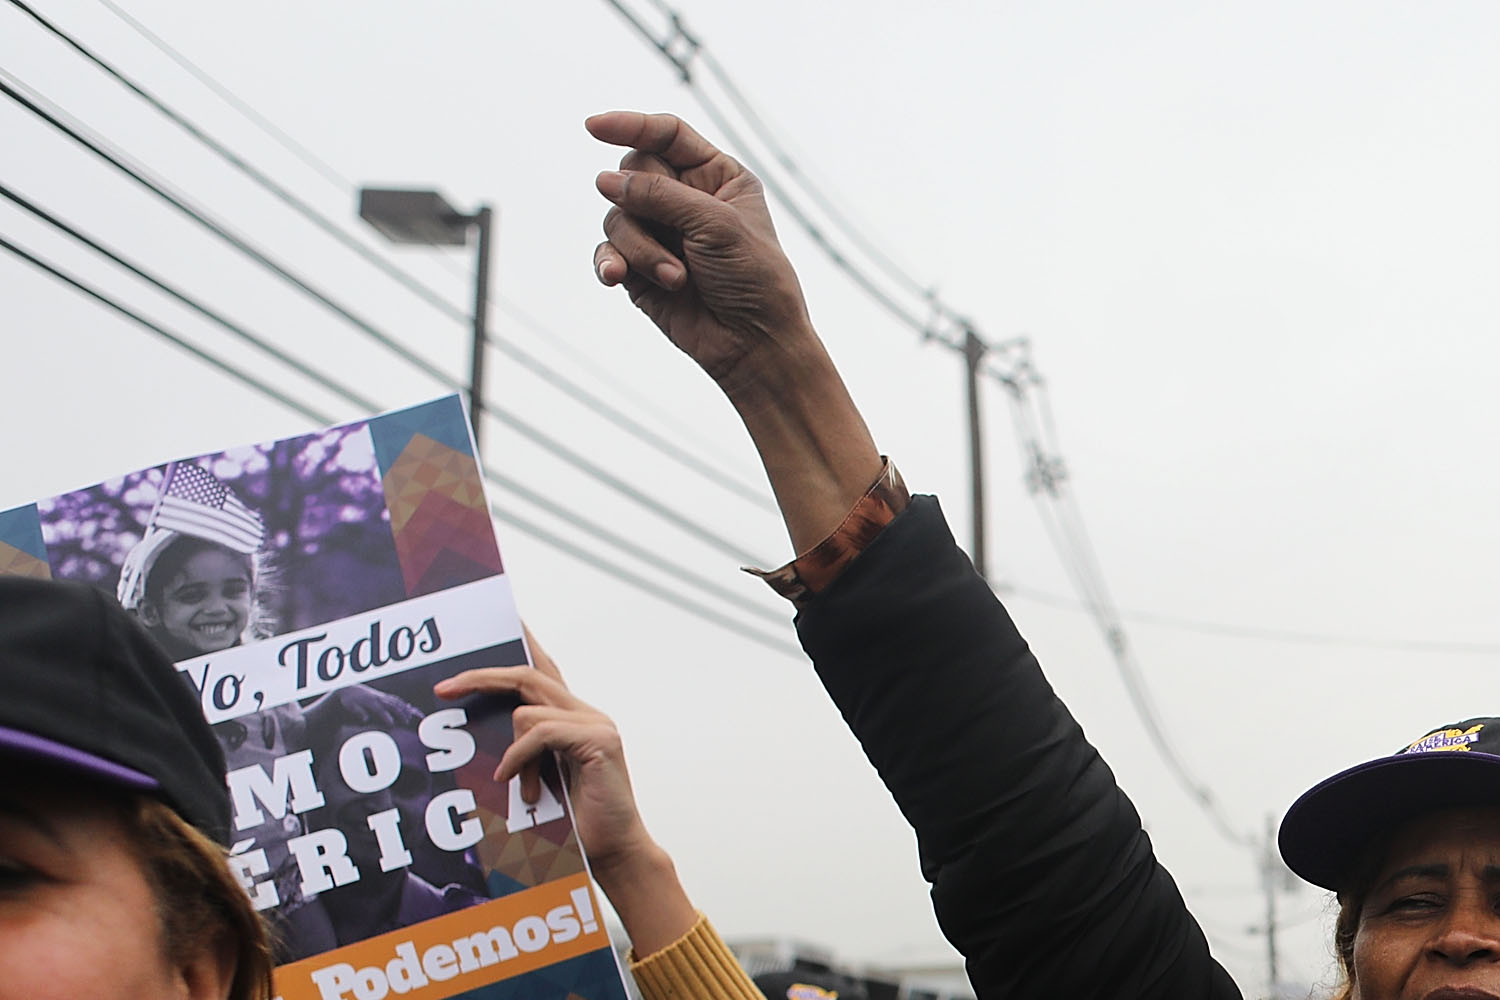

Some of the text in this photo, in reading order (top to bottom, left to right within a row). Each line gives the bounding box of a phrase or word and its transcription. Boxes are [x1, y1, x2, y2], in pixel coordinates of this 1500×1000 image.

[277, 616, 442, 690] Todos
[226, 708, 476, 831] MOS
[228, 775, 565, 911] ÉRICA
